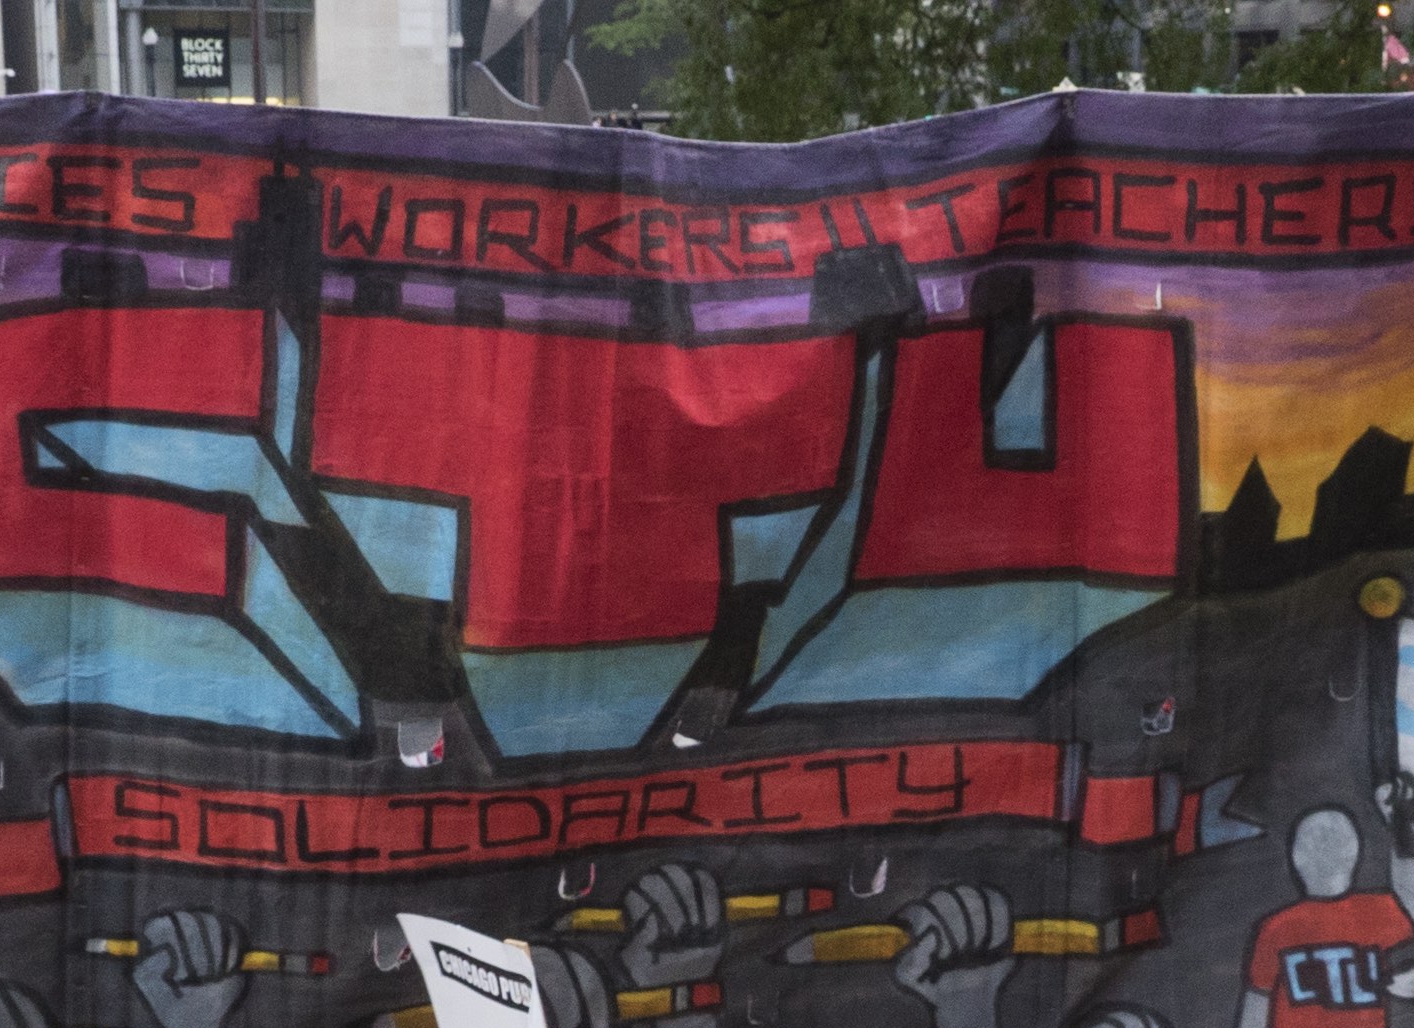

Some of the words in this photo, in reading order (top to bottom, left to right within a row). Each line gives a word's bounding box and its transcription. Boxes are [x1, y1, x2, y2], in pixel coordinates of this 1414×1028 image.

[181, 38, 224, 50] BLOCK
[182, 52, 224, 63] THIRTY
[183, 64, 222, 78] SEVEN
[331, 186, 796, 276] WORKERS
[113, 745, 971, 862] SOLIDARITY
[438, 949, 502, 998] CHICAGO
[1286, 946, 1381, 1004] CTU
